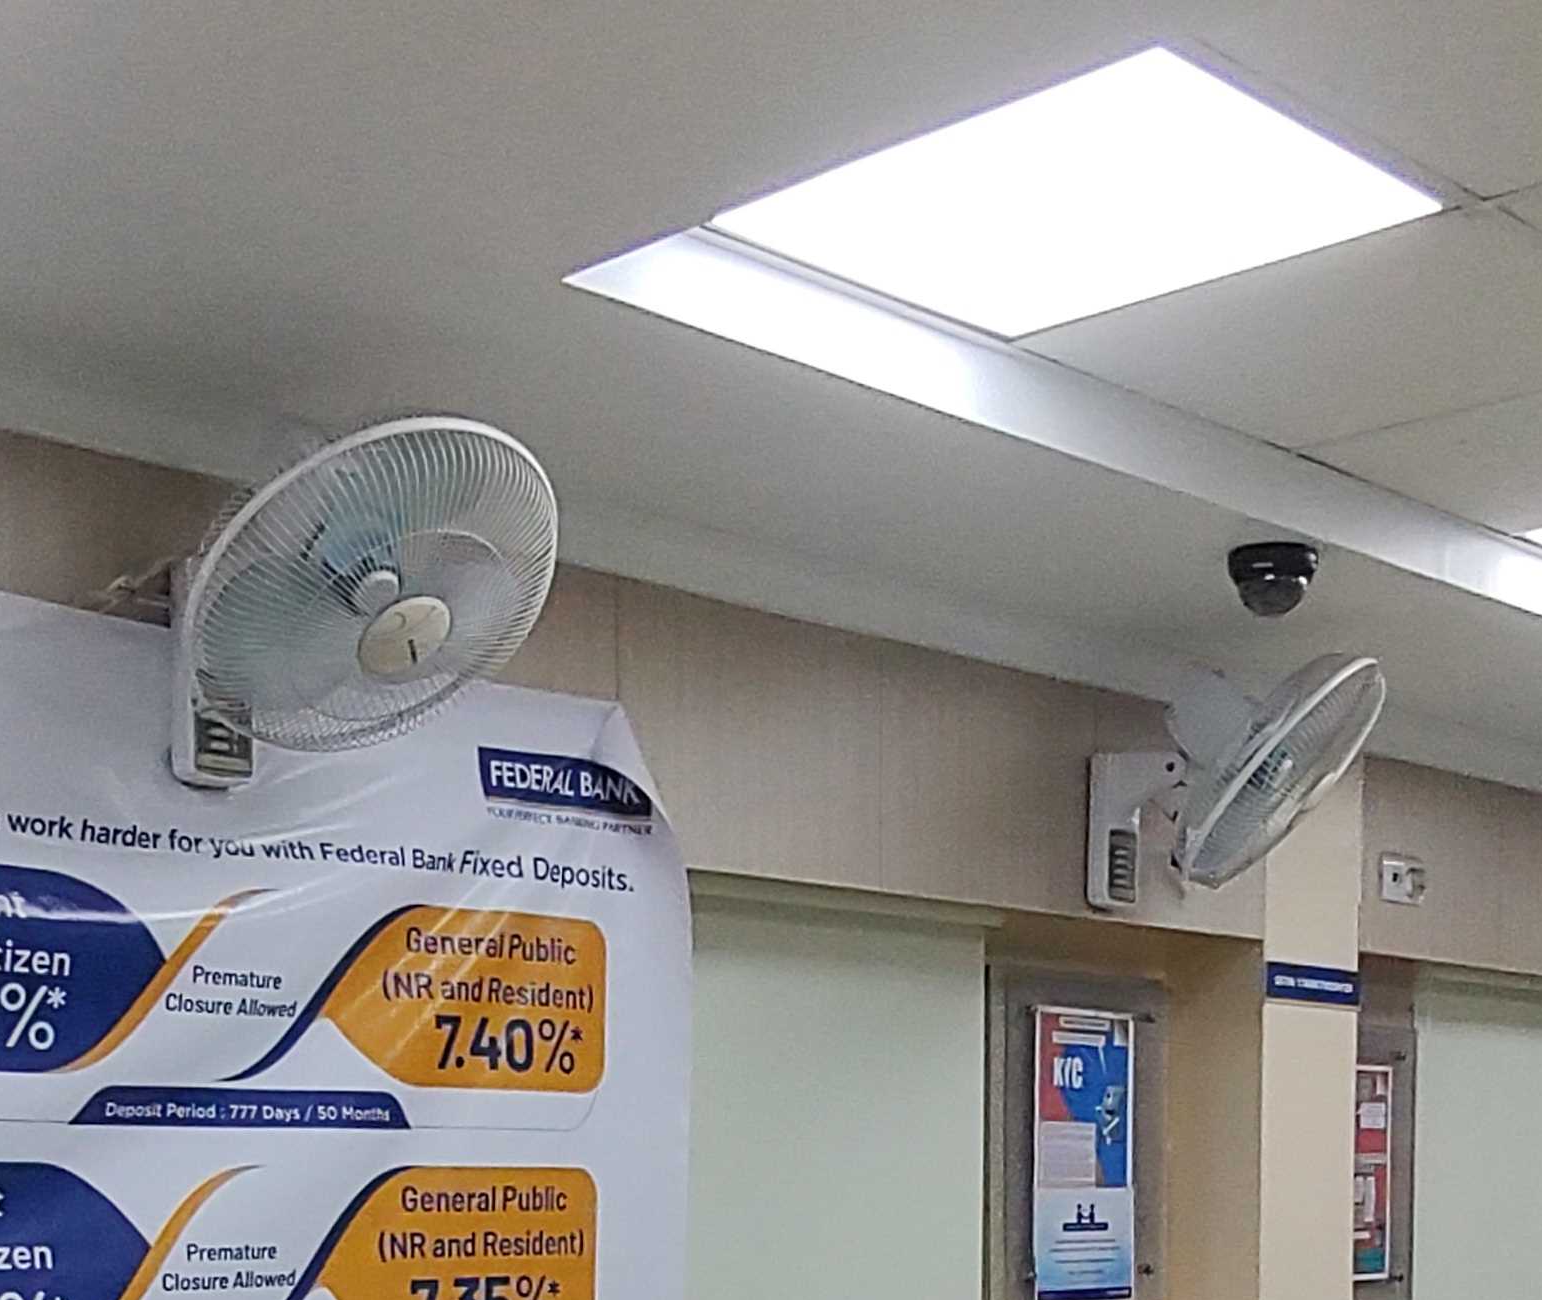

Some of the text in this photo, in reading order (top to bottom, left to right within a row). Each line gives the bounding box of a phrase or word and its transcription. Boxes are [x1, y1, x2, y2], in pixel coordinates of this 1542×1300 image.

[490, 760, 640, 805] FEDERAL BANK
[8, 814, 73, 840] work
[80, 819, 161, 849] harder
[168, 828, 202, 853] for
[209, 837, 254, 859] you
[262, 840, 314, 860] with
[321, 842, 405, 867] Federal
[413, 849, 456, 873] Bank
[459, 850, 523, 879] Fixed
[533, 857, 634, 892] Deposits.
[406, 927, 577, 965] General Public
[192, 965, 282, 990] Premature
[382, 970, 594, 1013] (NR and Resident)
[165, 992, 298, 1018] Closure Allowed
[105, 1102, 161, 1120] Deposit
[166, 1103, 216, 1120] Period
[229, 1105, 257, 1120] 777
[262, 1105, 300, 1123] Days
[304, 1104, 313, 1122] /
[317, 1106, 337, 1120] 50
[341, 1105, 390, 1122] Months
[401, 1186, 568, 1212] General Public
[186, 1243, 278, 1262] Premature
[378, 1229, 584, 1263] (NR and Resident)
[162, 1268, 297, 1291] Closure Allowed
